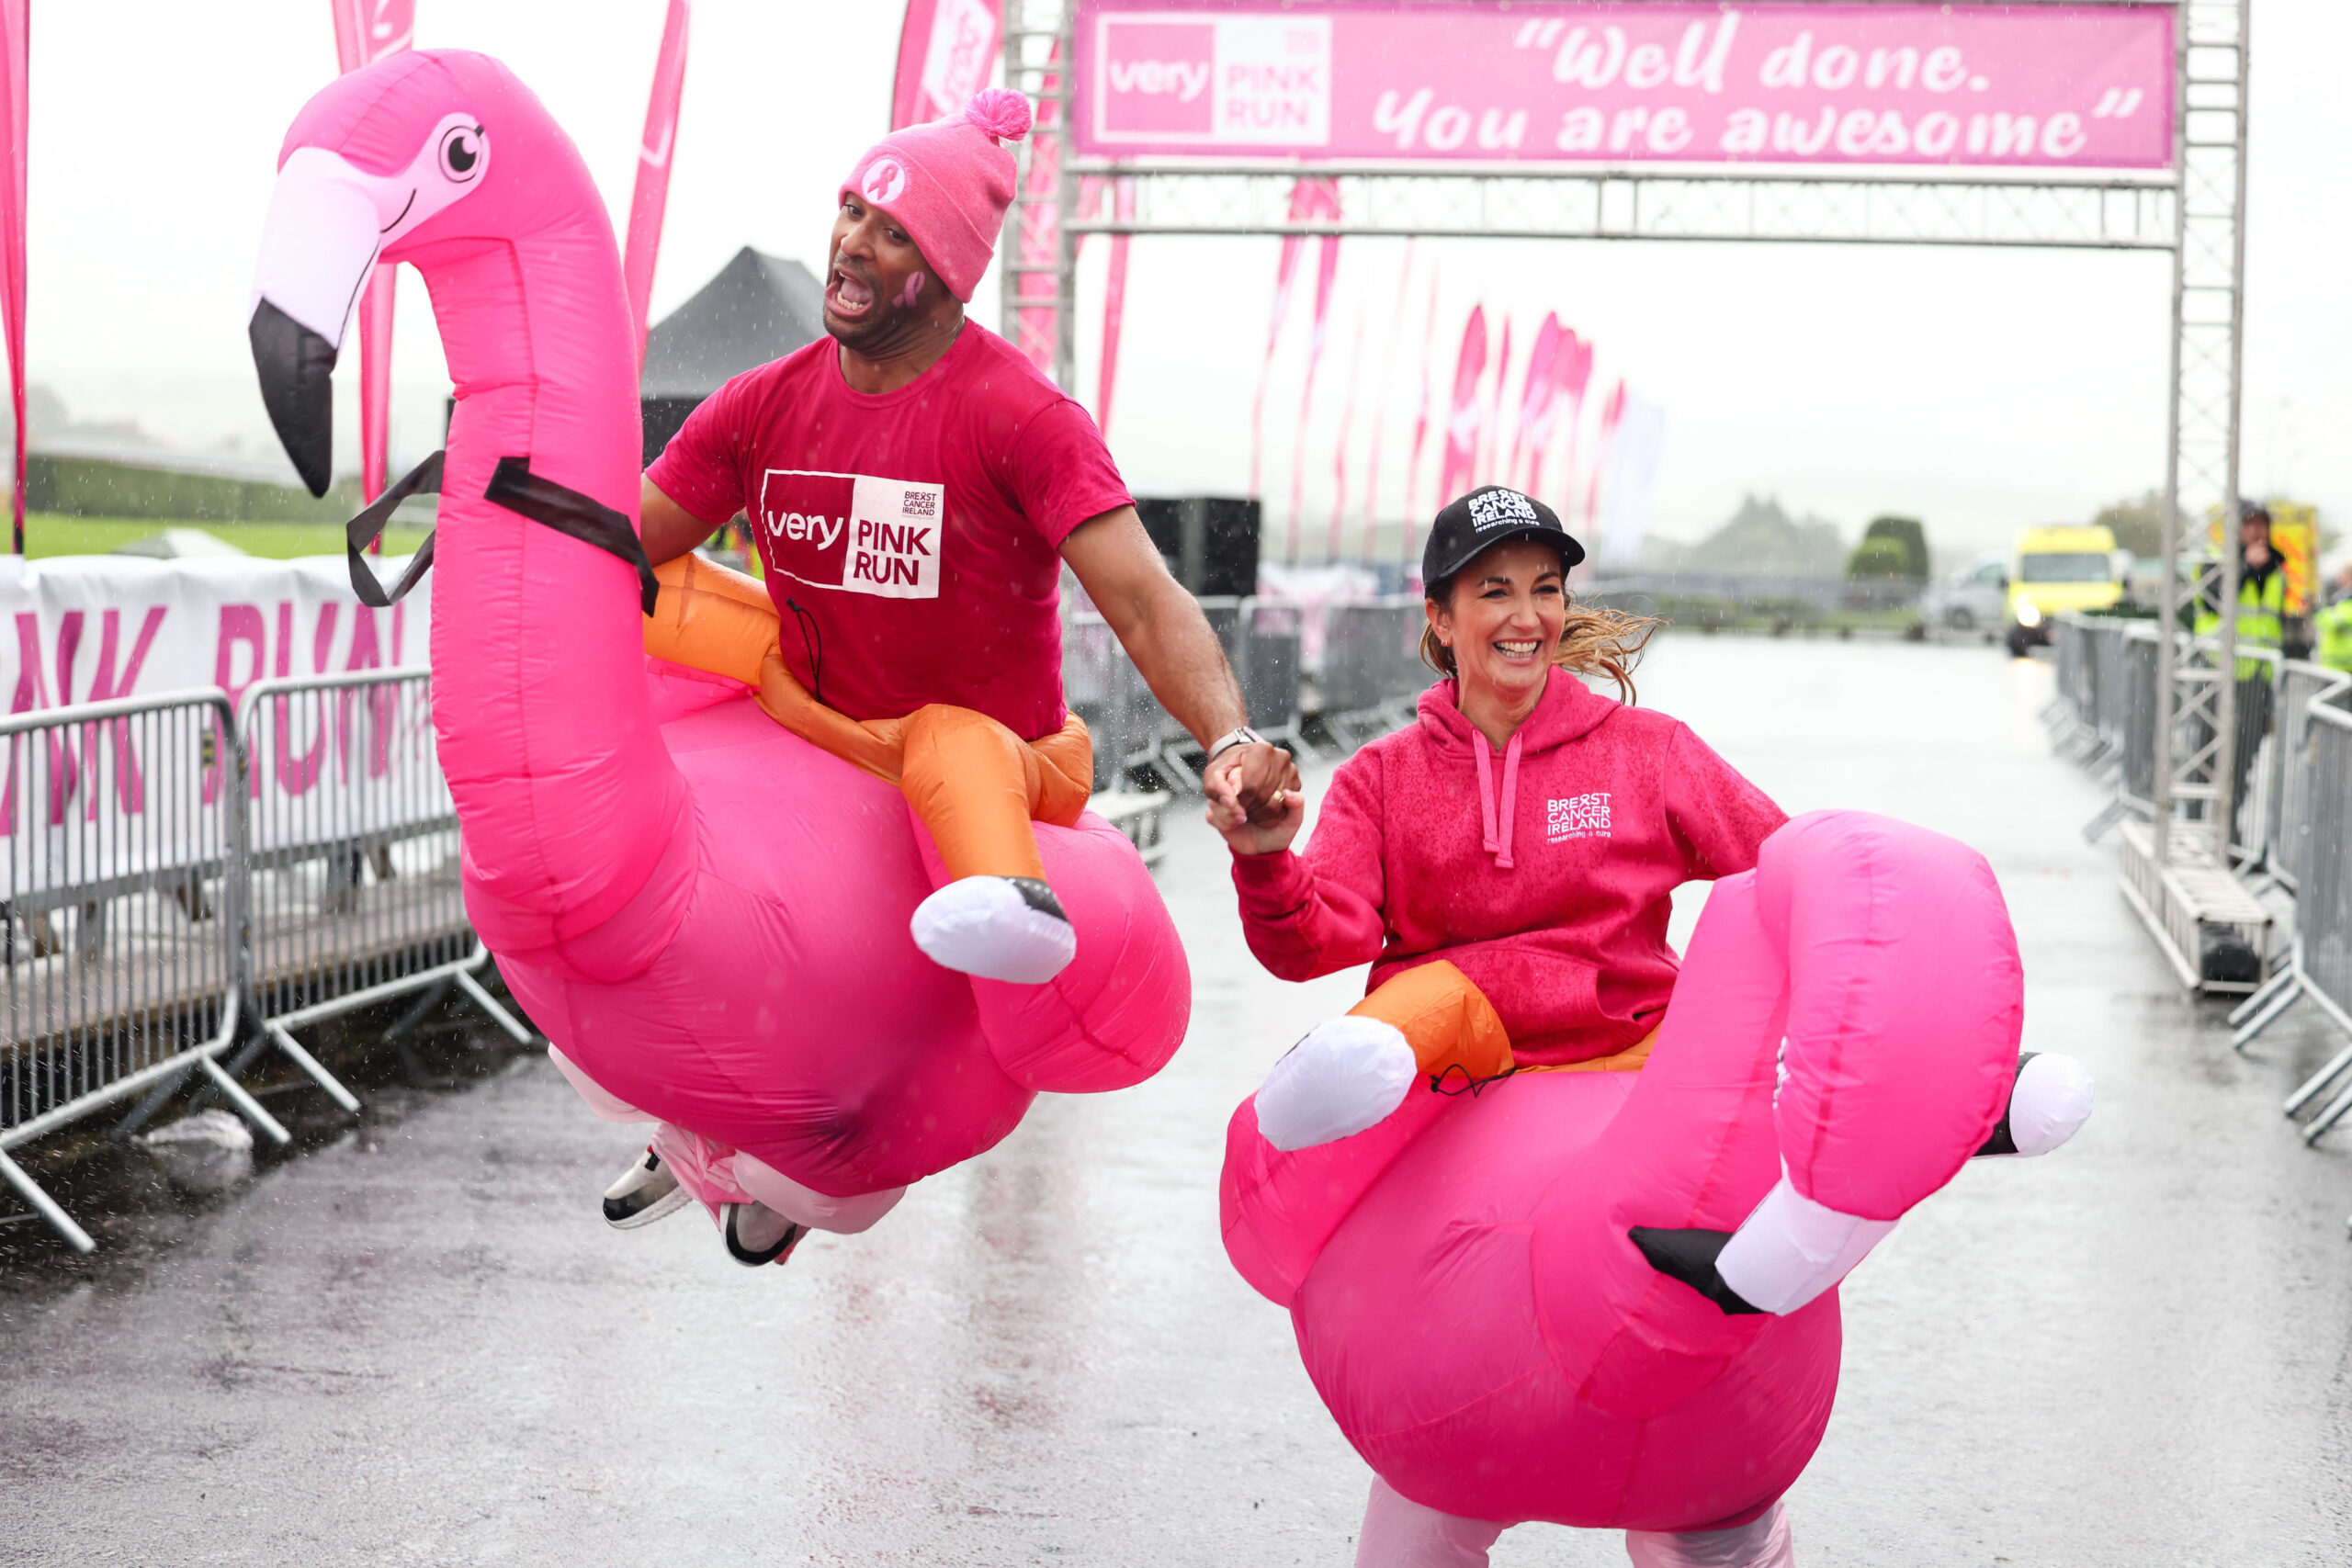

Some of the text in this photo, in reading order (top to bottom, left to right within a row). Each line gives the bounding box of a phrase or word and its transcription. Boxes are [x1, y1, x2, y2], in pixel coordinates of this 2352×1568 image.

[1758, 30, 1991, 92] done.
[1109, 59, 1210, 102] very
[1227, 63, 1319, 94] PINK
[1227, 97, 1310, 128] RUN
[1373, 87, 1531, 152] You
[1555, 106, 1694, 153] are
[902, 506, 935, 516] IRELAND
[903, 499, 935, 509] CANCER
[1470, 496, 1532, 517] CANCER
[1472, 508, 1537, 527] IRELAND
[767, 510, 844, 551] very
[857, 519, 932, 556] PINK
[1476, 518, 1518, 533] researching
[854, 551, 919, 586] RUN
[201, 600, 405, 805] RUN
[1547, 806, 1611, 823] CANCER
[1547, 817, 1611, 836] IRELAND
